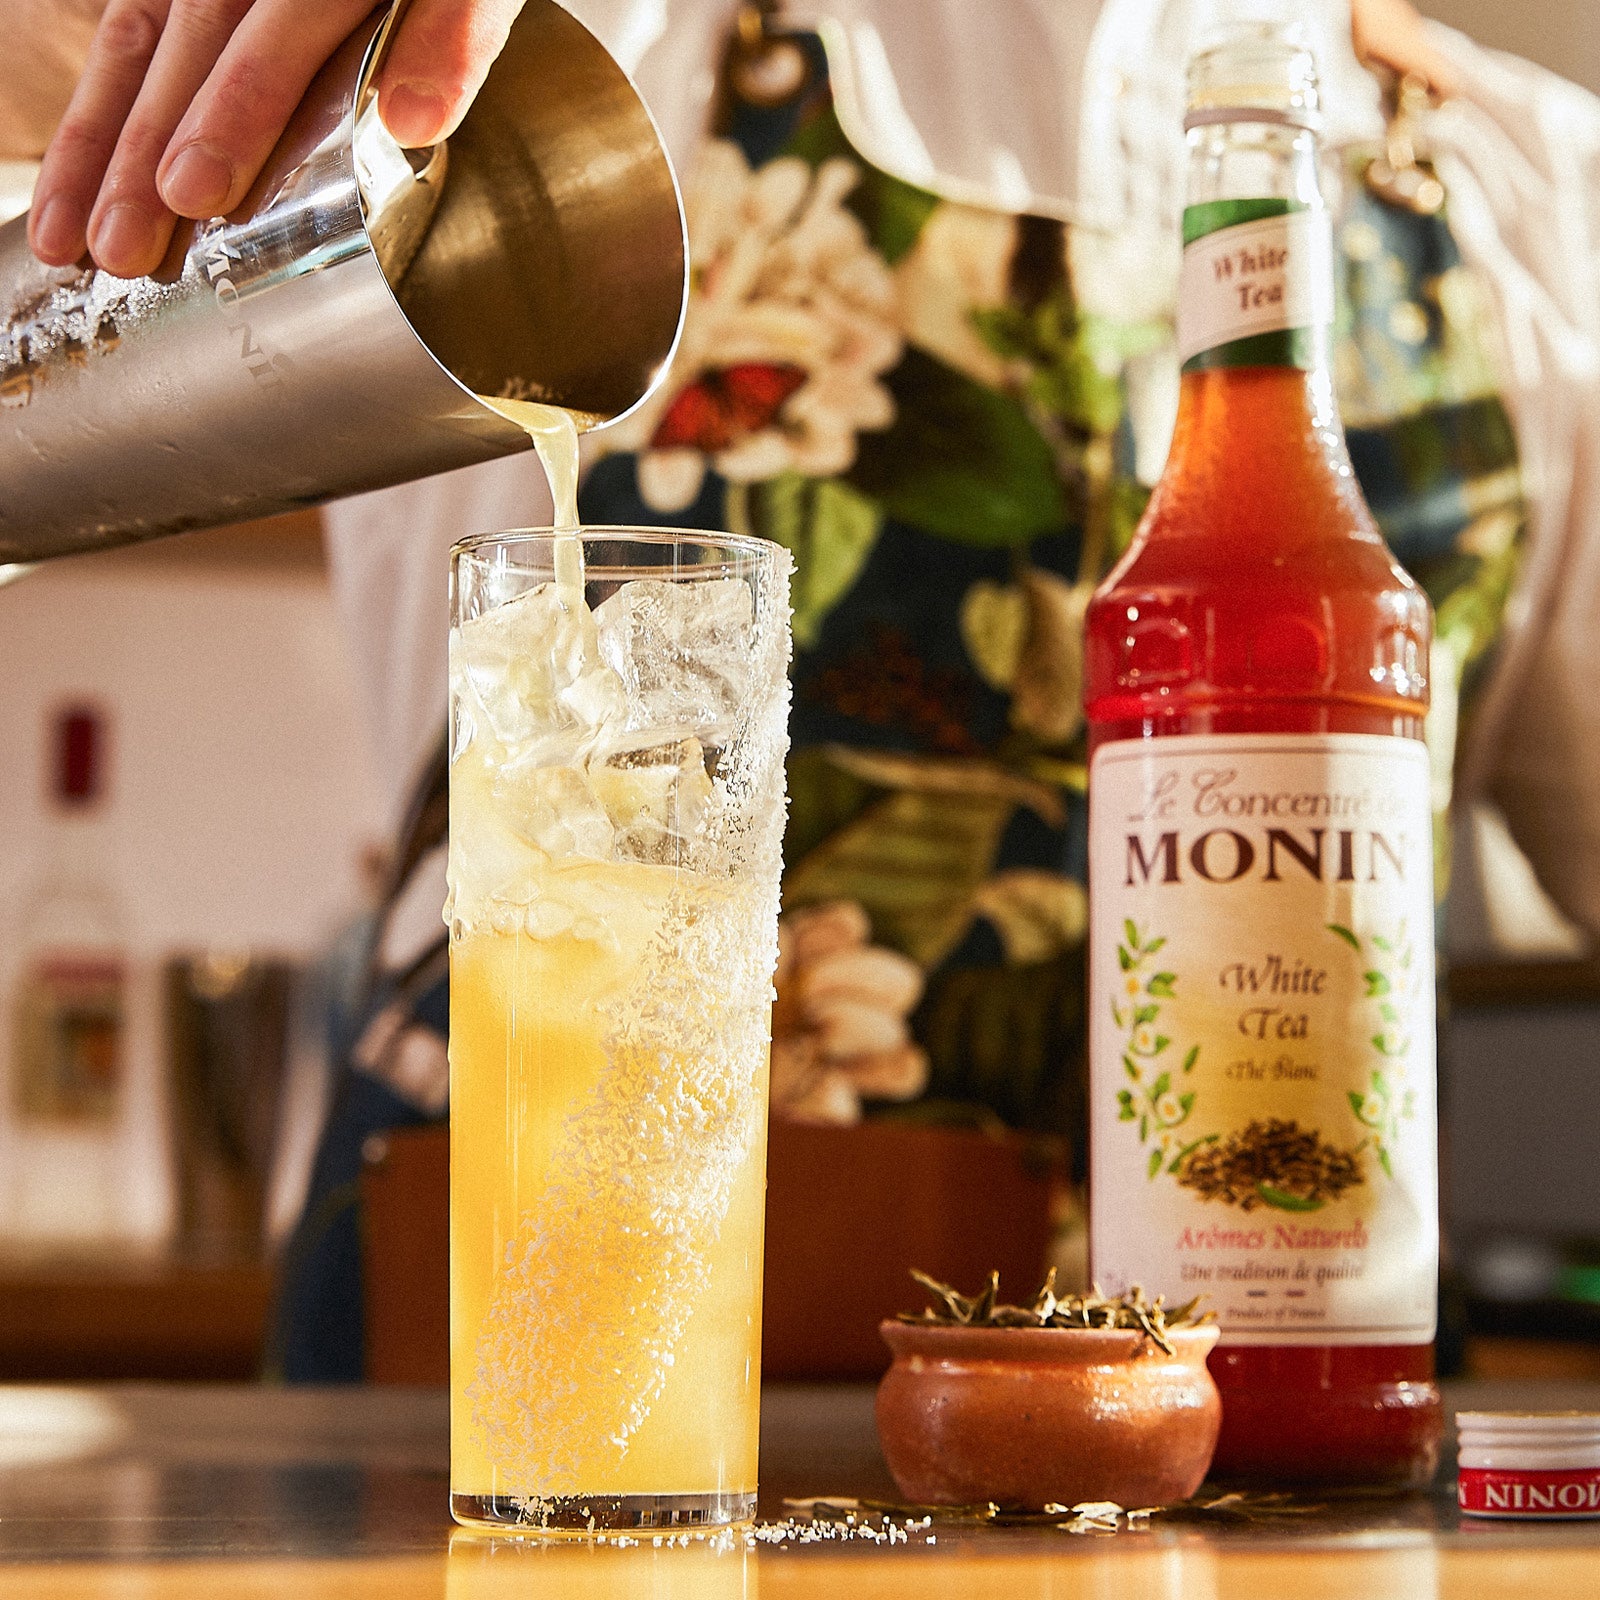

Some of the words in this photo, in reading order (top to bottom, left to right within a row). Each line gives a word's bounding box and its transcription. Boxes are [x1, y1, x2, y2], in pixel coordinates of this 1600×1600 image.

[1214, 245, 1287, 281] White
[1236, 282, 1283, 310] Tea
[1124, 827, 1406, 886] MONIN
[1218, 953, 1328, 996] White
[1238, 1005, 1309, 1040] Tea
